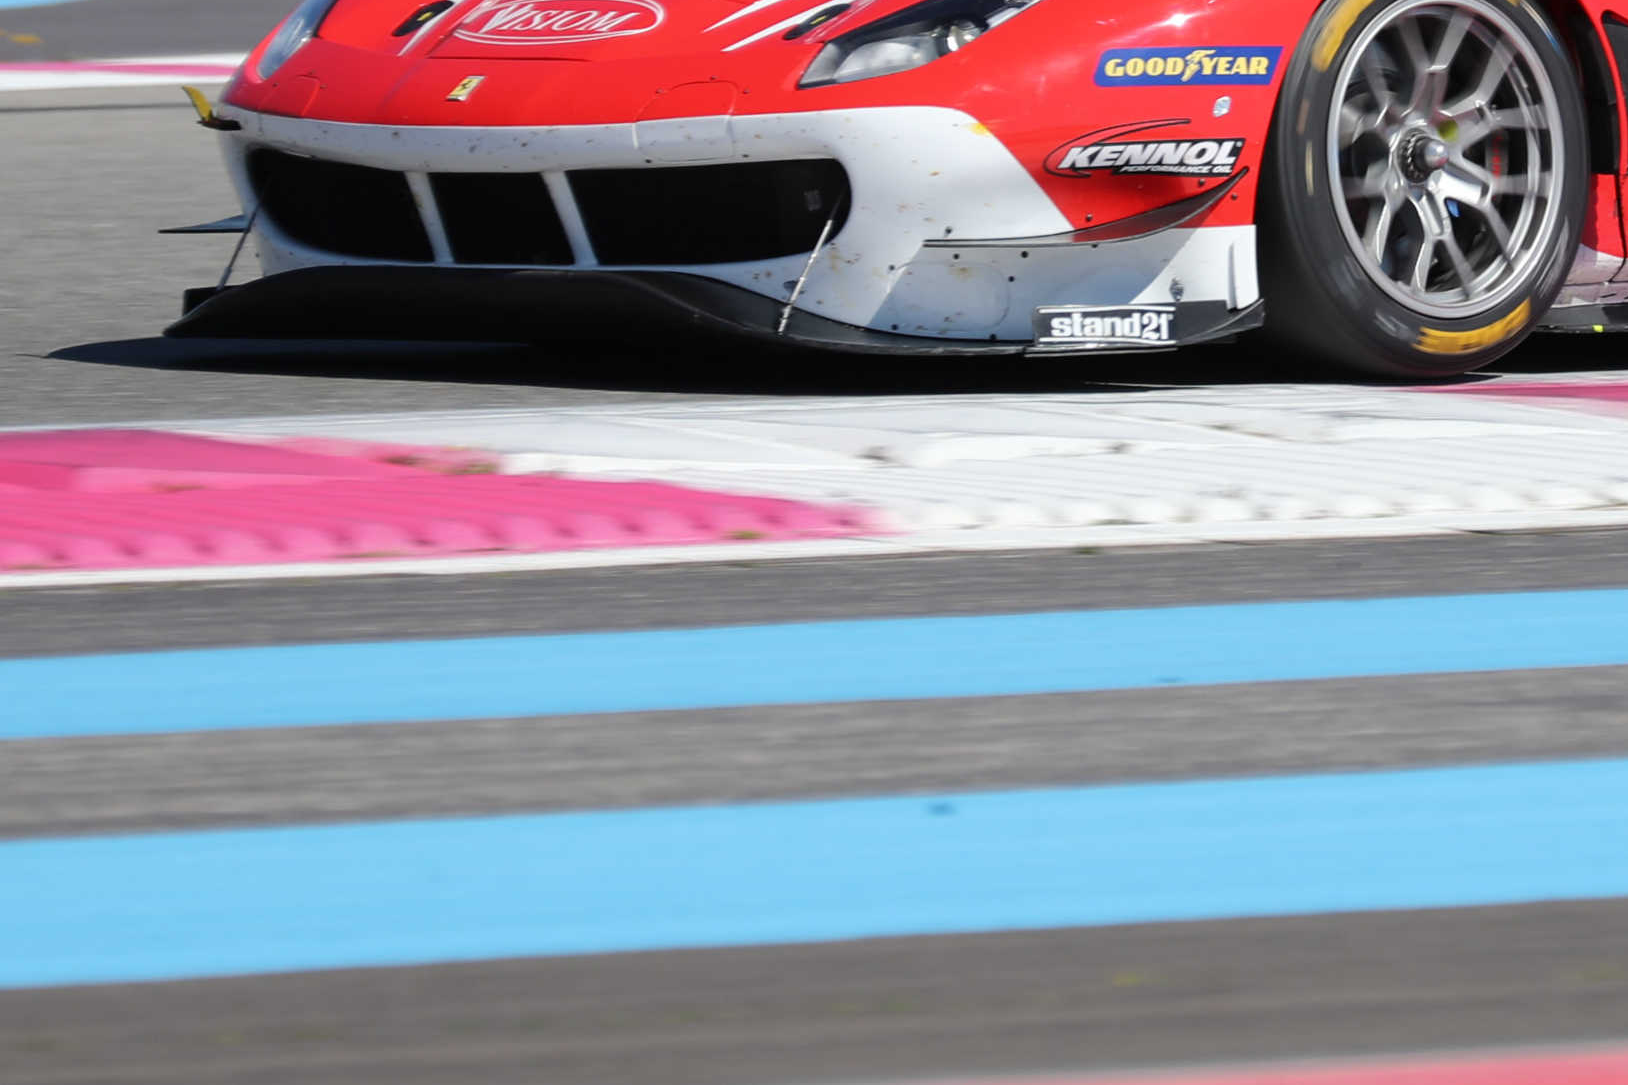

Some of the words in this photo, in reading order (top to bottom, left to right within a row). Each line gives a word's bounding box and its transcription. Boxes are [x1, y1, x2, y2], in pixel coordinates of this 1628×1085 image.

[478, 2, 641, 34] VISIOM
[1056, 140, 1243, 170] KENNOL
[1050, 312, 1174, 340] stand21
